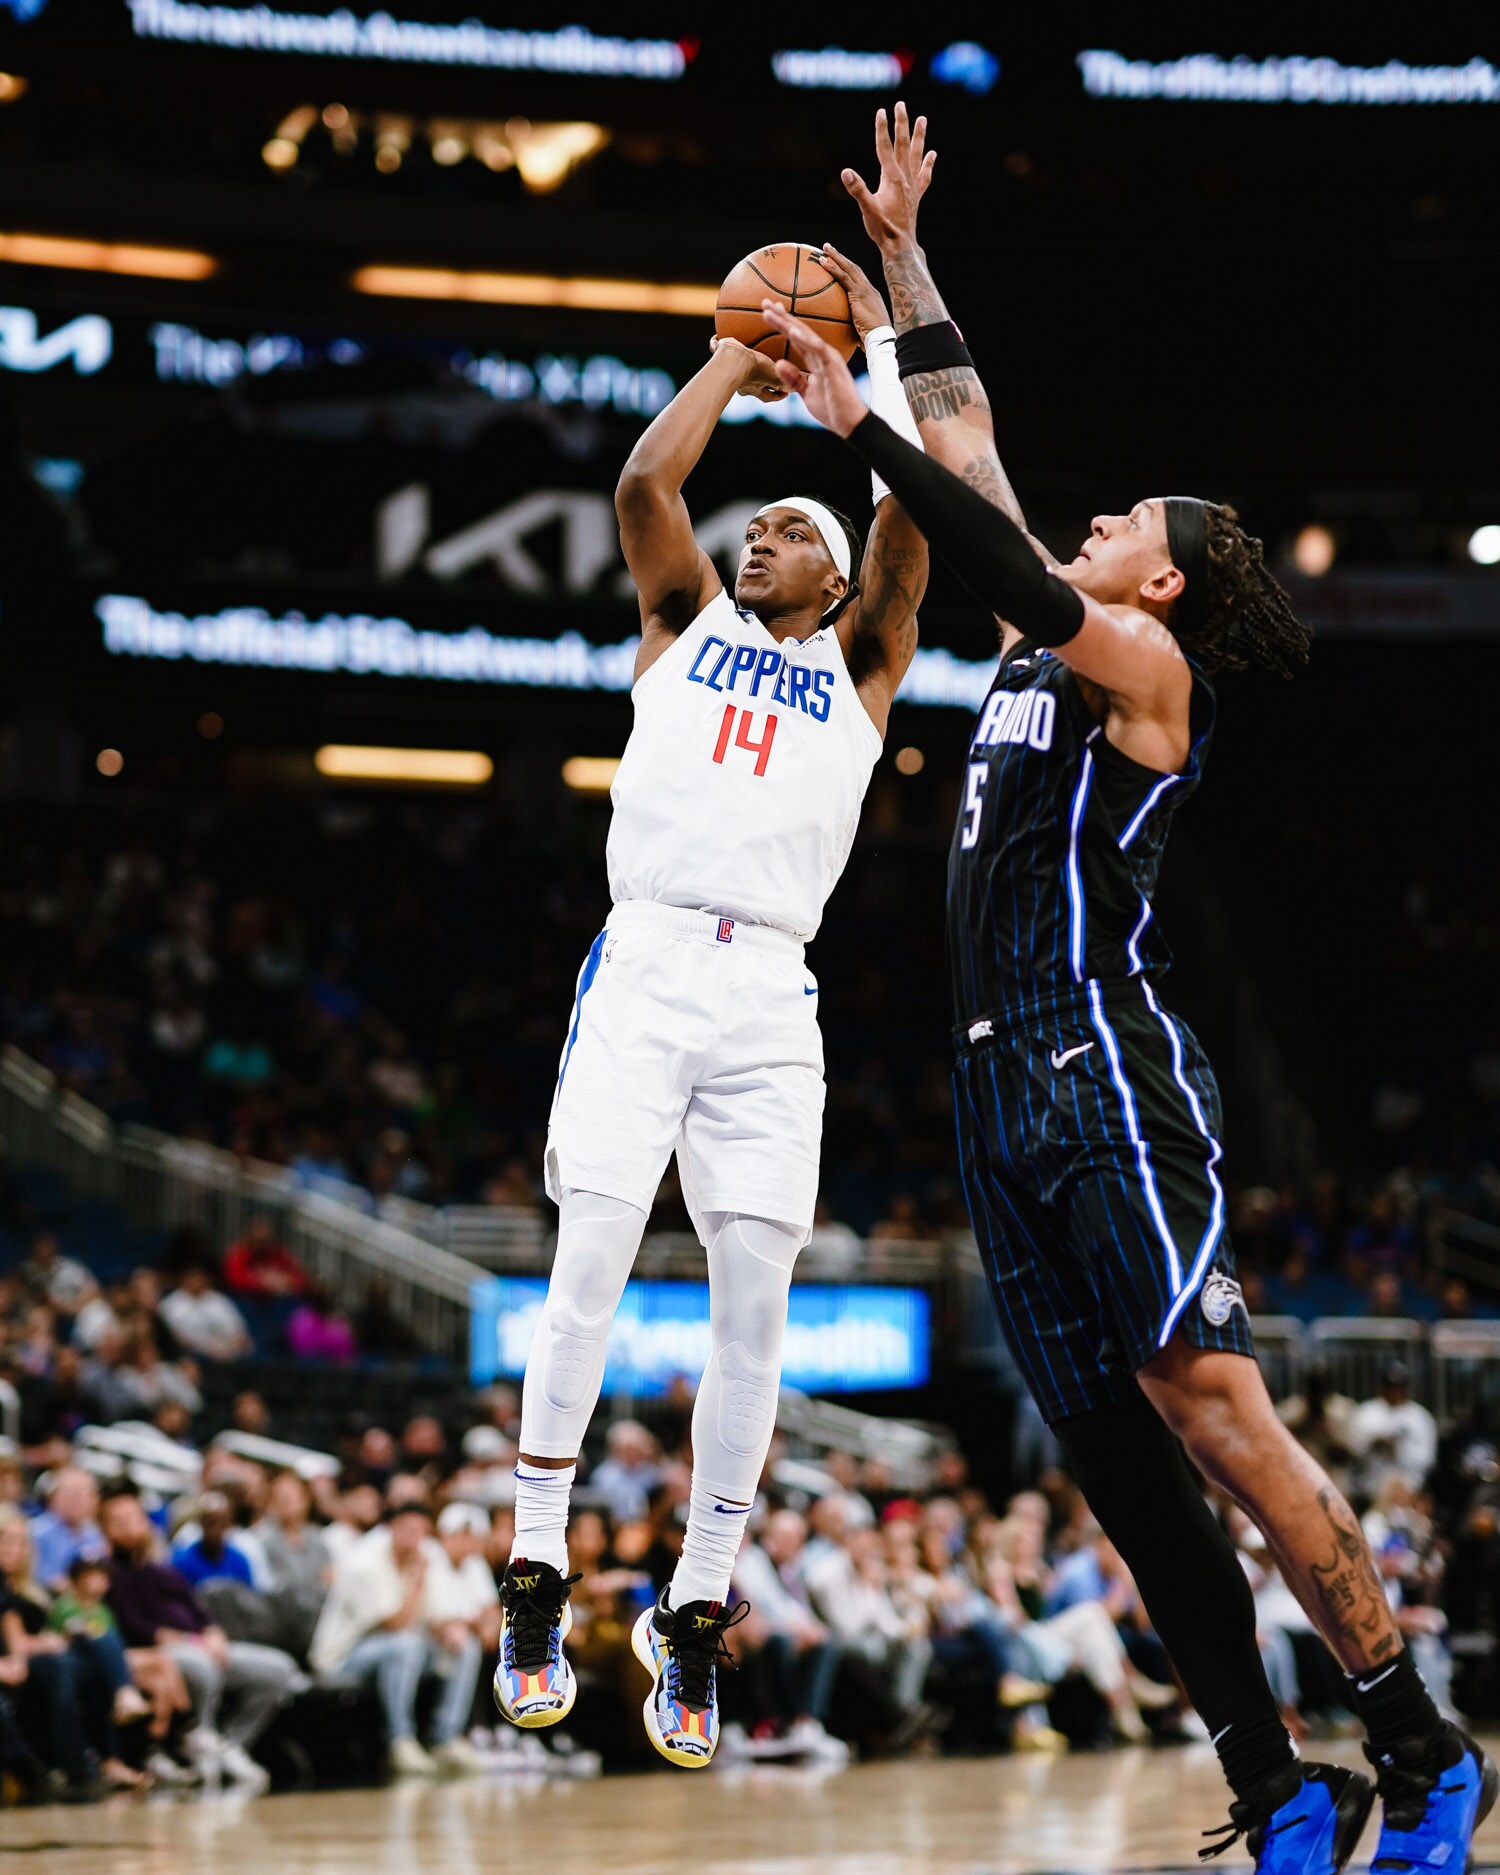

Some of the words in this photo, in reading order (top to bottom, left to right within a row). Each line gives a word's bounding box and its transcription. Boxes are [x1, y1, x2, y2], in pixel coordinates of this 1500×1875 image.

[686, 635, 834, 723] CLPPERS
[712, 703, 778, 777] 14
[960, 761, 989, 850] 5
